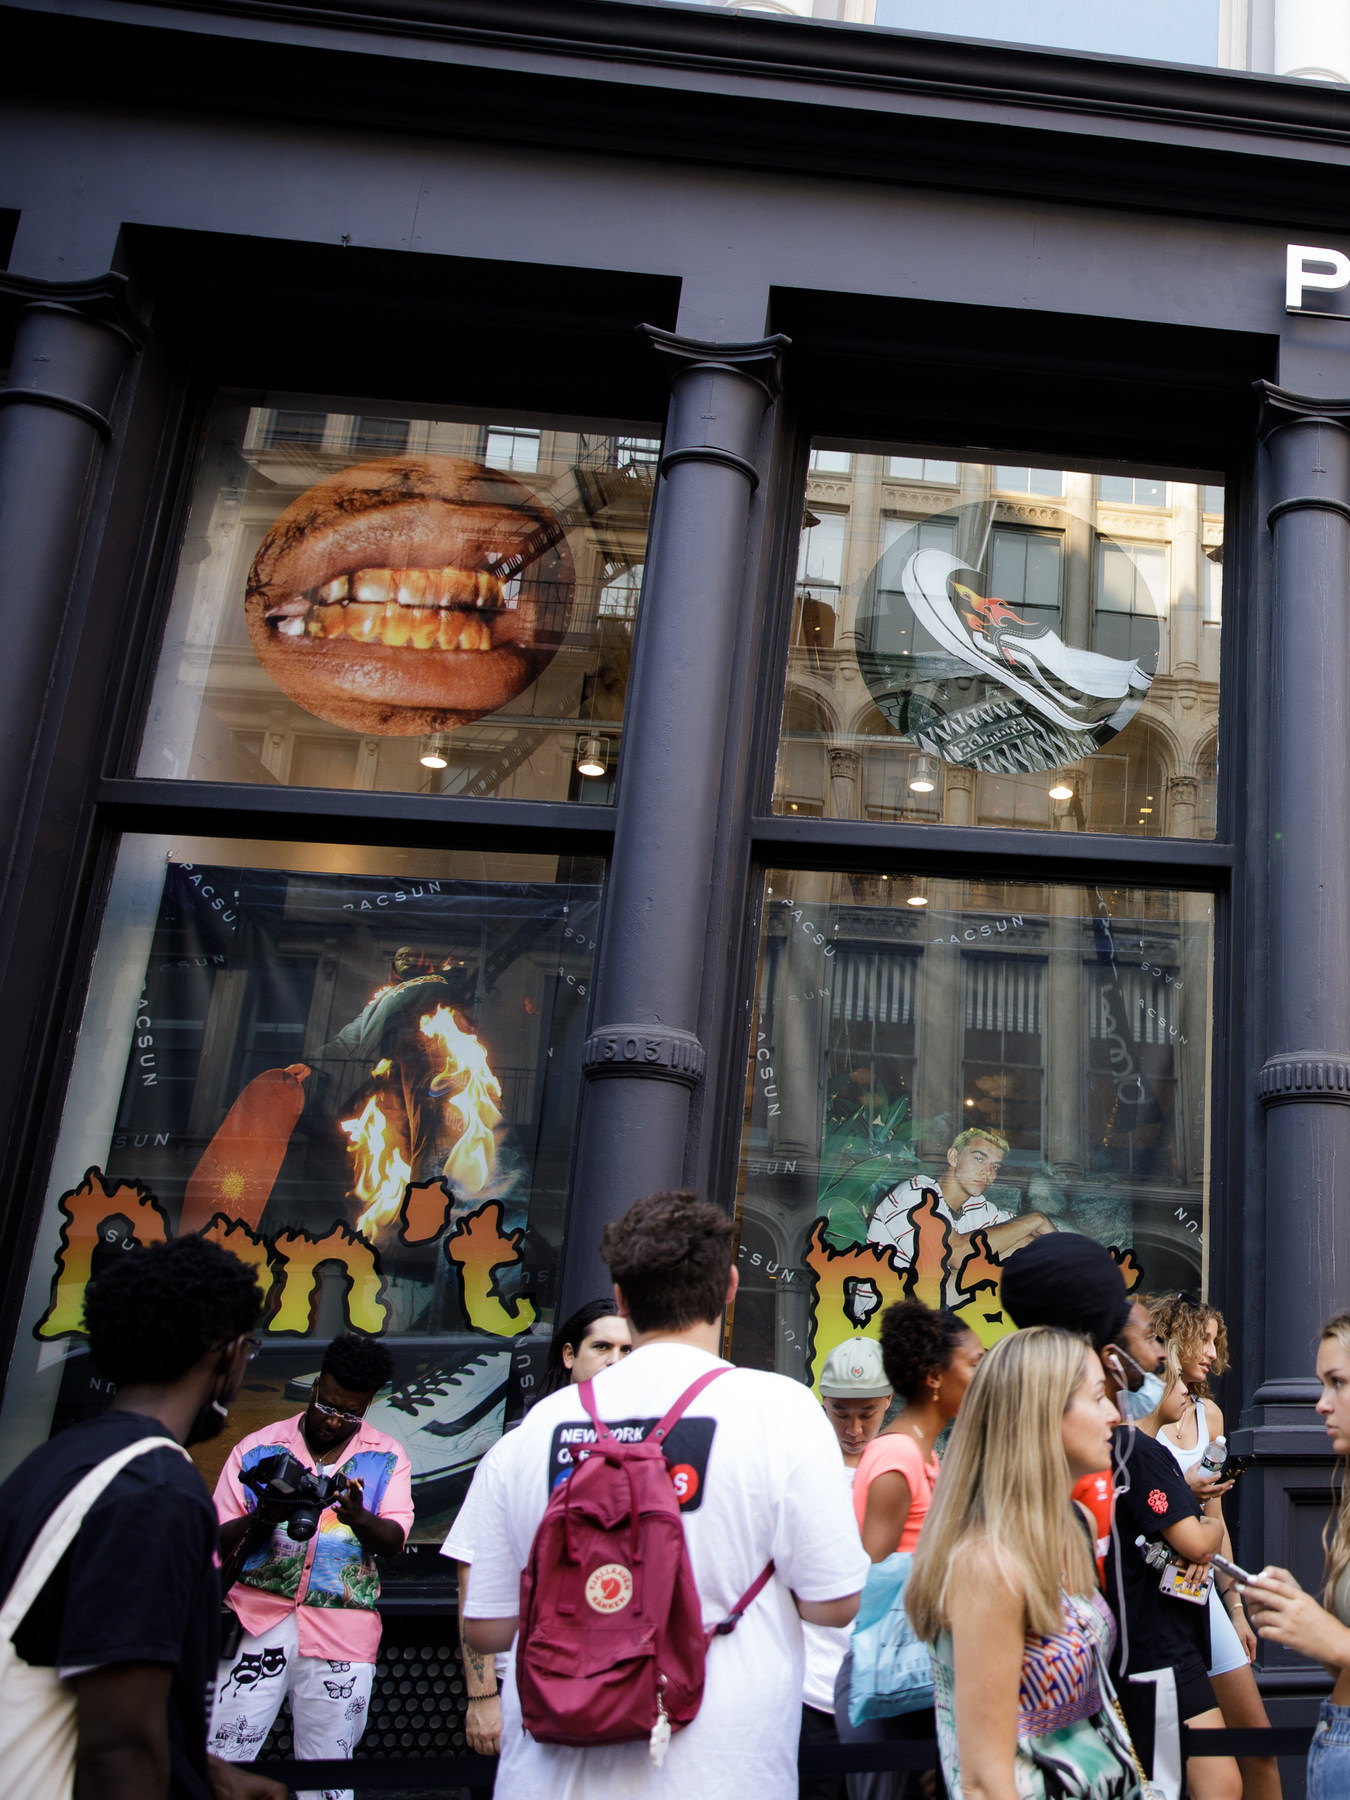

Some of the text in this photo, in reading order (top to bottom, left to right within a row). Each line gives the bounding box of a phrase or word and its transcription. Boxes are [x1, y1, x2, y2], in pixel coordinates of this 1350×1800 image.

[179, 863, 237, 931] PACSU
[933, 915, 1025, 944] ACSUN
[136, 980, 158, 1087] ACSUN
[602, 1035, 662, 1062] 503
[757, 1014, 782, 1117] ACSUN
[559, 1426, 645, 1444] NEW ORK
